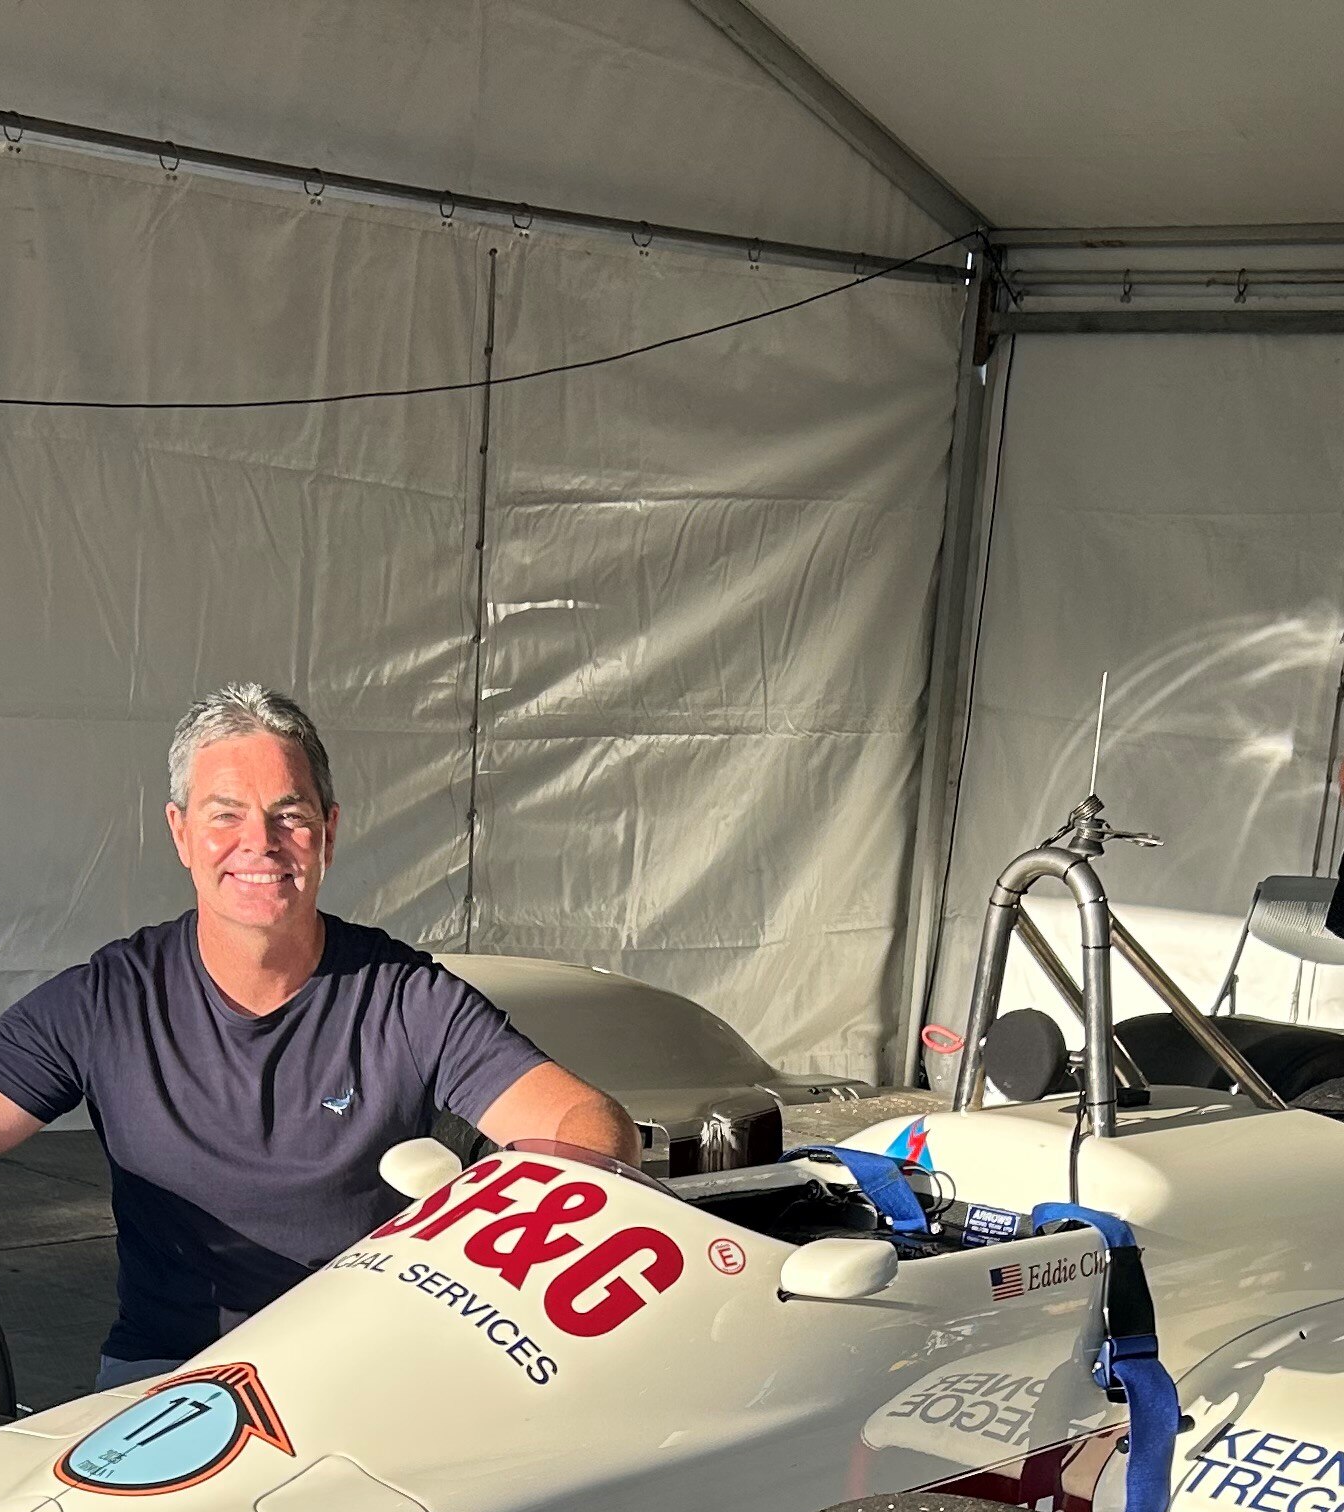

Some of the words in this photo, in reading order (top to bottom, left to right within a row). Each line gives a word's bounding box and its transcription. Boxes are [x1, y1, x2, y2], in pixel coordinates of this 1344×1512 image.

[370, 1159, 685, 1338] SF&G
[1027, 1258, 1077, 1291] Eddie
[398, 1263, 559, 1386] SERVICES
[123, 1396, 212, 1446] 17
